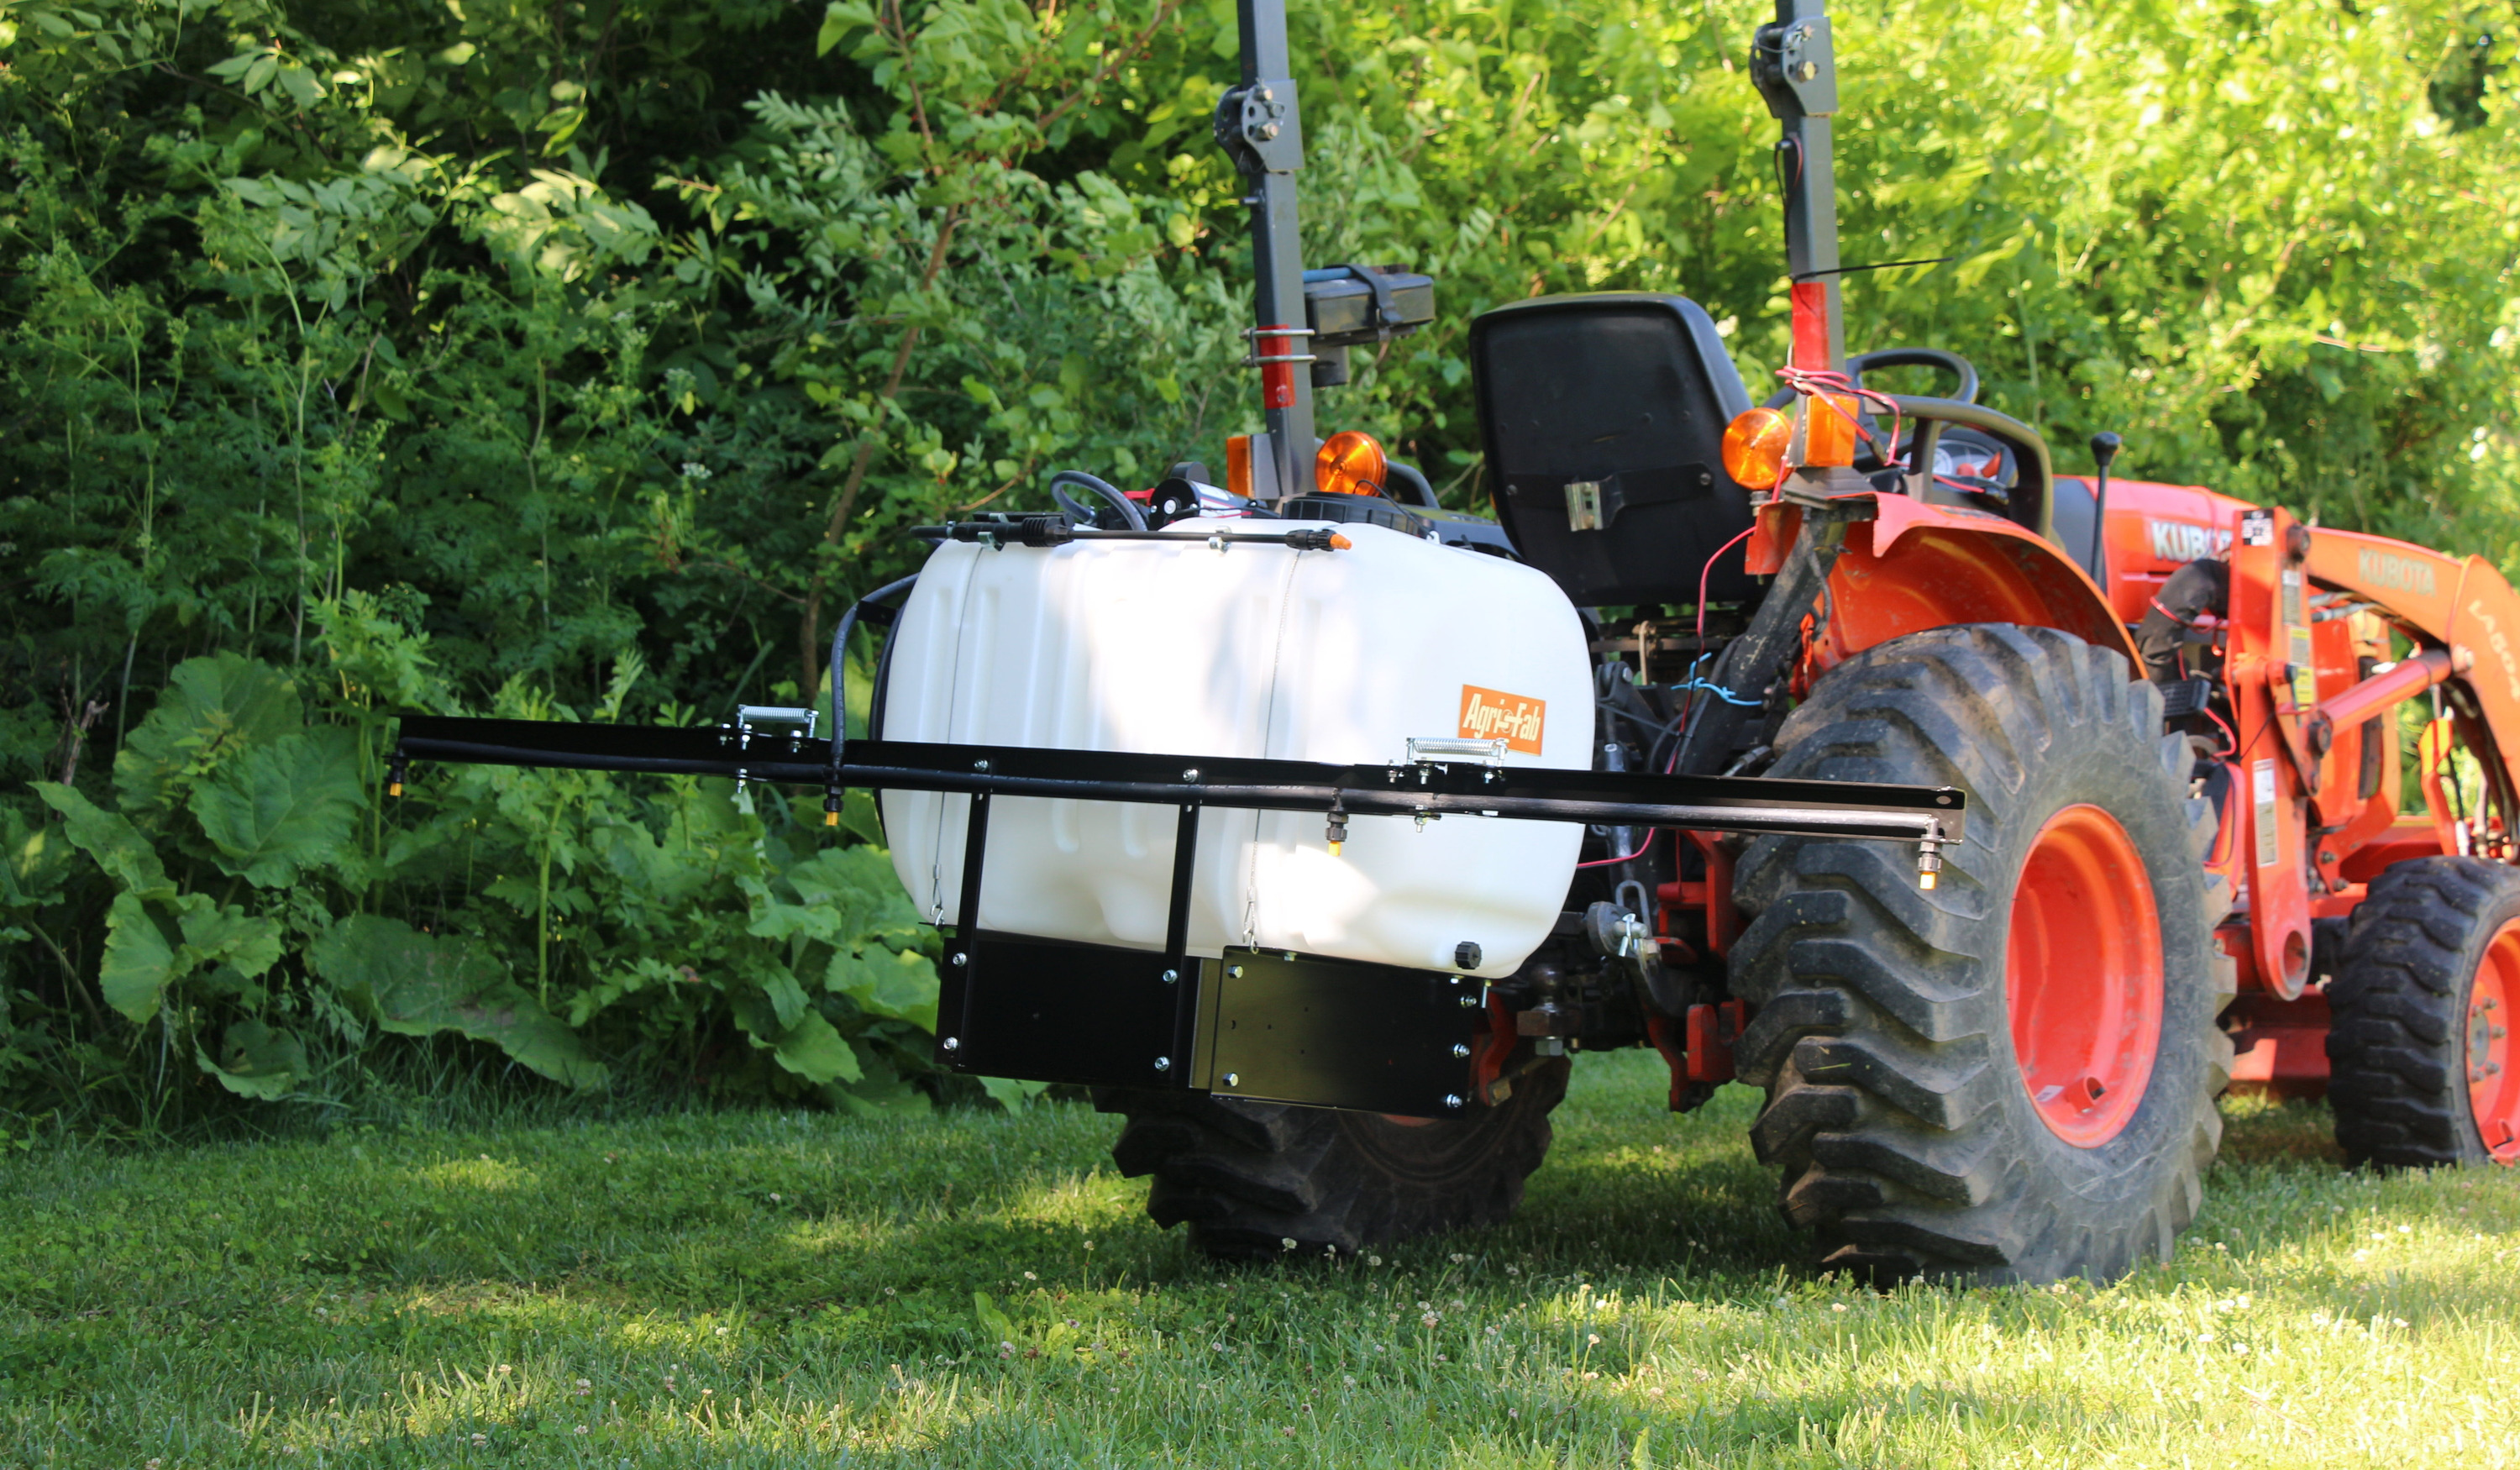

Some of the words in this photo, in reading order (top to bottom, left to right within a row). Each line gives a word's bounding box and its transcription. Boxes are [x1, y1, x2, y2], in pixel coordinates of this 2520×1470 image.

[2152, 520, 2234, 563] KUBO
[2359, 547, 2435, 598] KUBOTA
[1462, 693, 1541, 741] Agri-Fab
